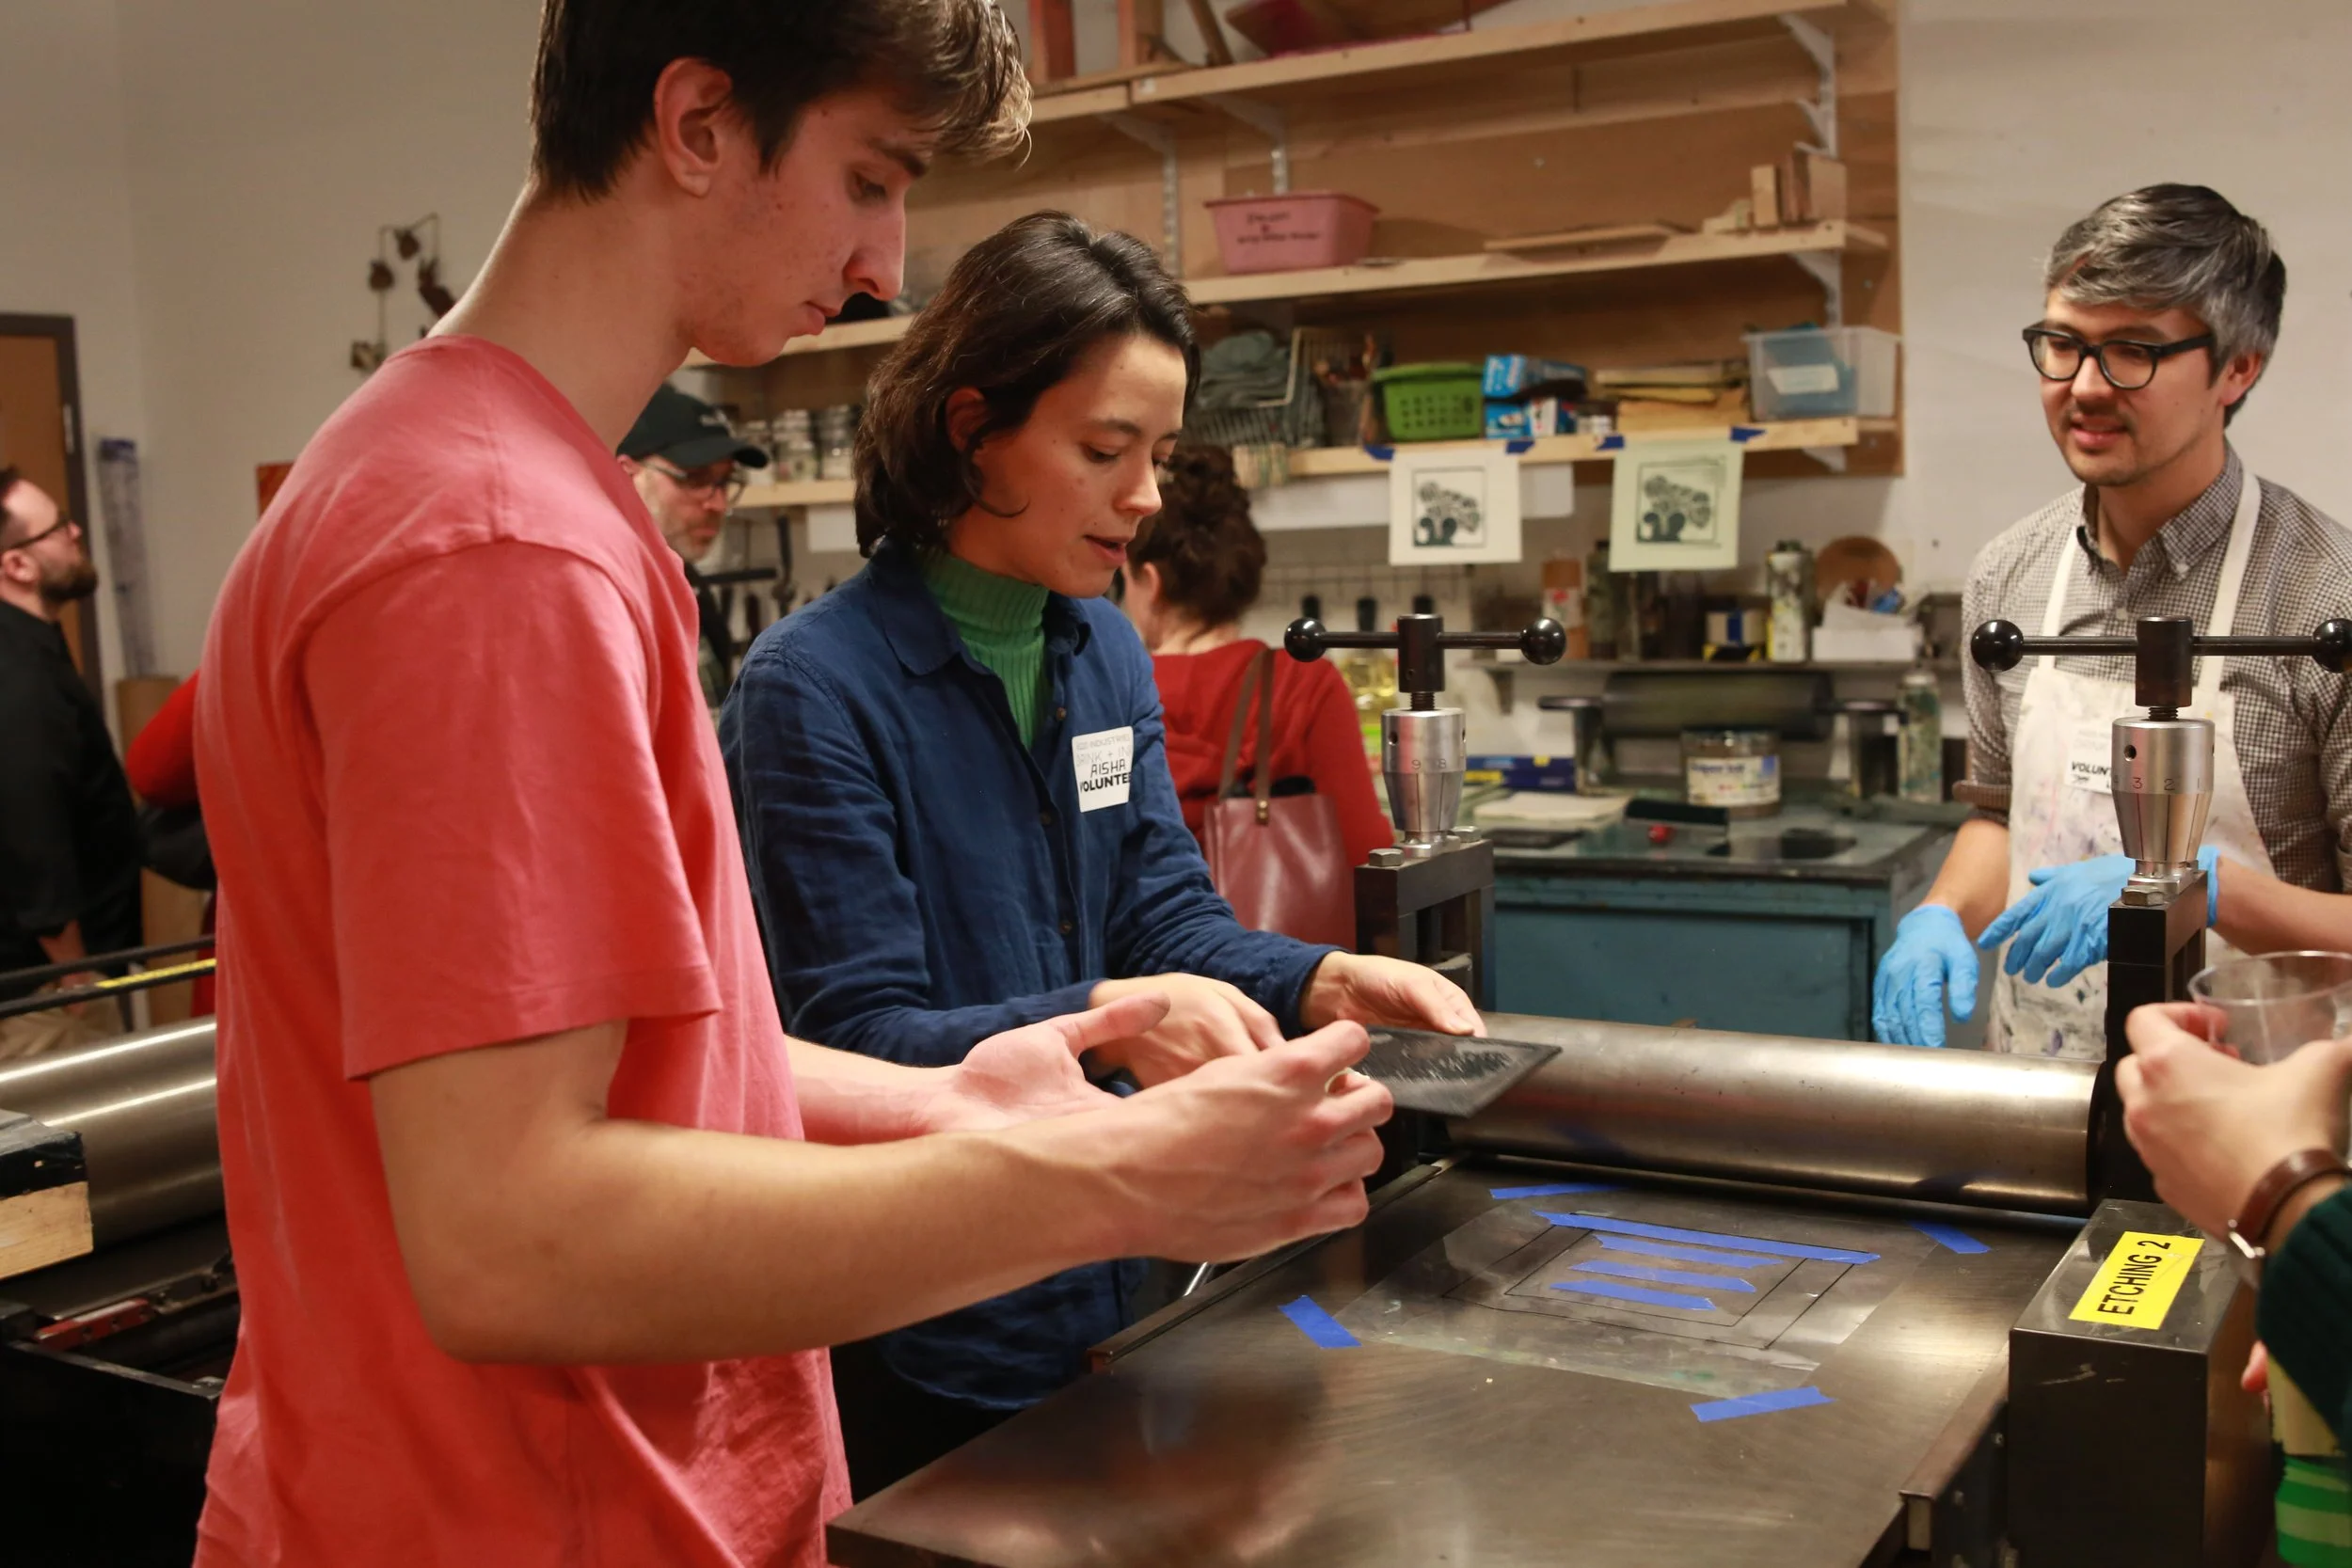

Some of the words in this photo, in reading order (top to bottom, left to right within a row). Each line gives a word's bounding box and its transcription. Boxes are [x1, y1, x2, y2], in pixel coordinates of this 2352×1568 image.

[1090, 758, 1126, 778] AISHA
[1411, 759, 1422, 770] 9
[1438, 758, 1447, 769] 8
[2132, 777, 2143, 789] 3
[2164, 778, 2175, 791] 2
[2097, 1254, 2162, 1315] ETCHING
[2137, 1240, 2171, 1250] 2
